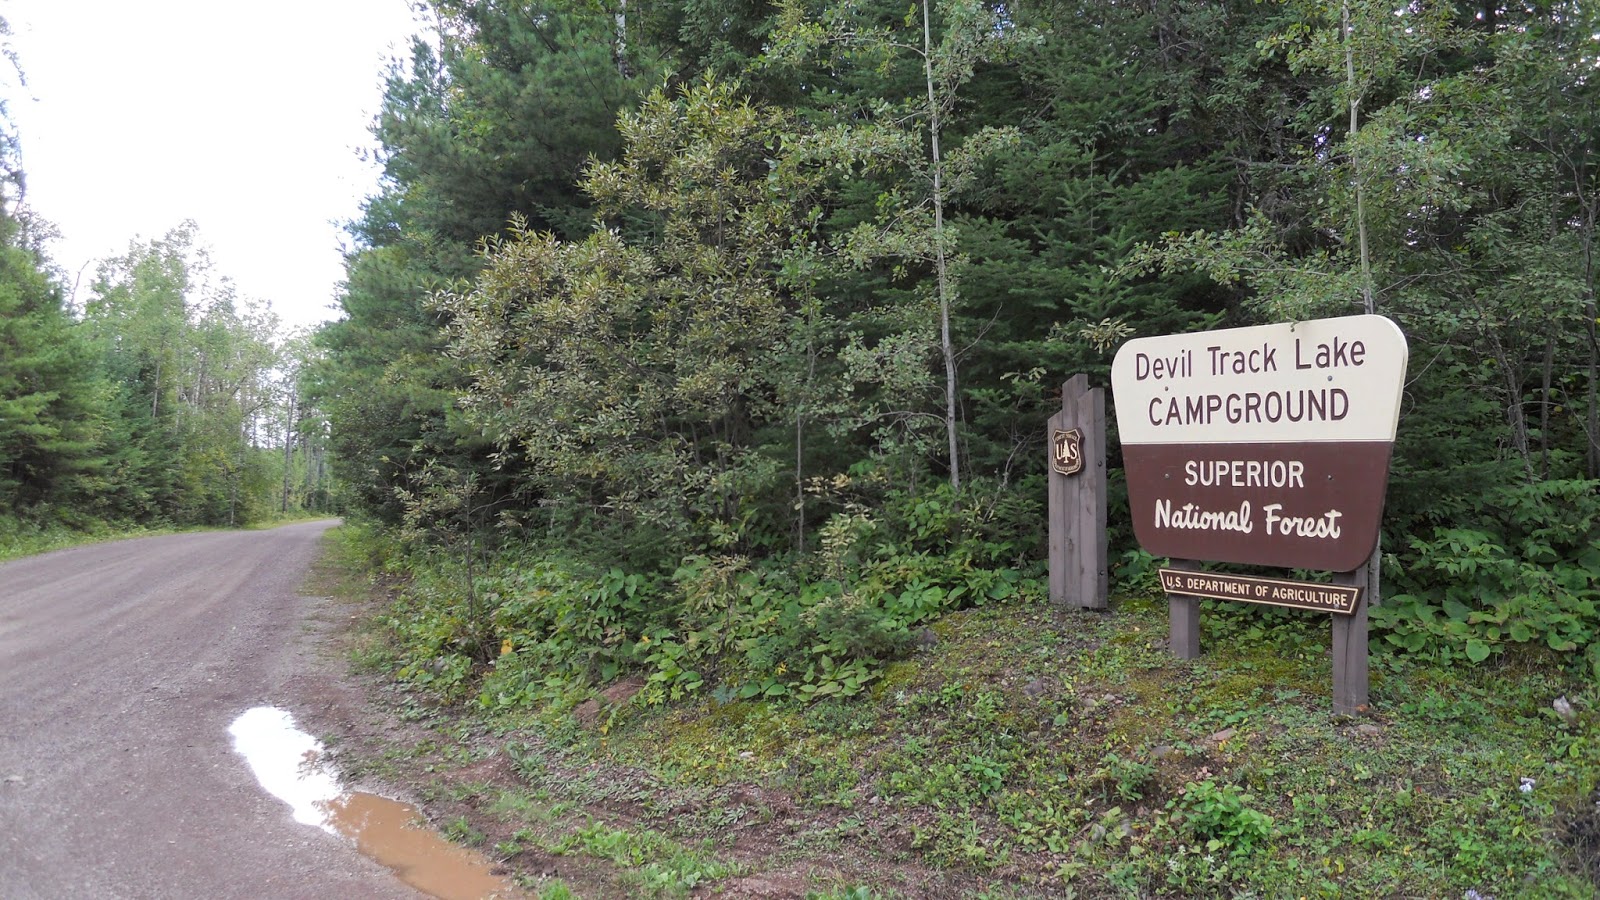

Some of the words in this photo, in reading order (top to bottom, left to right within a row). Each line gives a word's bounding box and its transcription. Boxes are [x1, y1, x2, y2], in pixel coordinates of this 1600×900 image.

[1136, 349, 1192, 381] Devil
[1207, 343, 1277, 376] Track
[1295, 336, 1366, 370] Lake
[1149, 388, 1350, 426] CAMPGROUND
[1185, 460, 1304, 488] SUPERIOR
[1155, 499, 1253, 534] National
[1263, 503, 1343, 539] Forest
[1166, 576, 1184, 588] U.S.
[1187, 578, 1250, 595] DEPARTMENT
[1255, 585, 1268, 597] OF
[1272, 587, 1348, 606] AGRICULTURE
